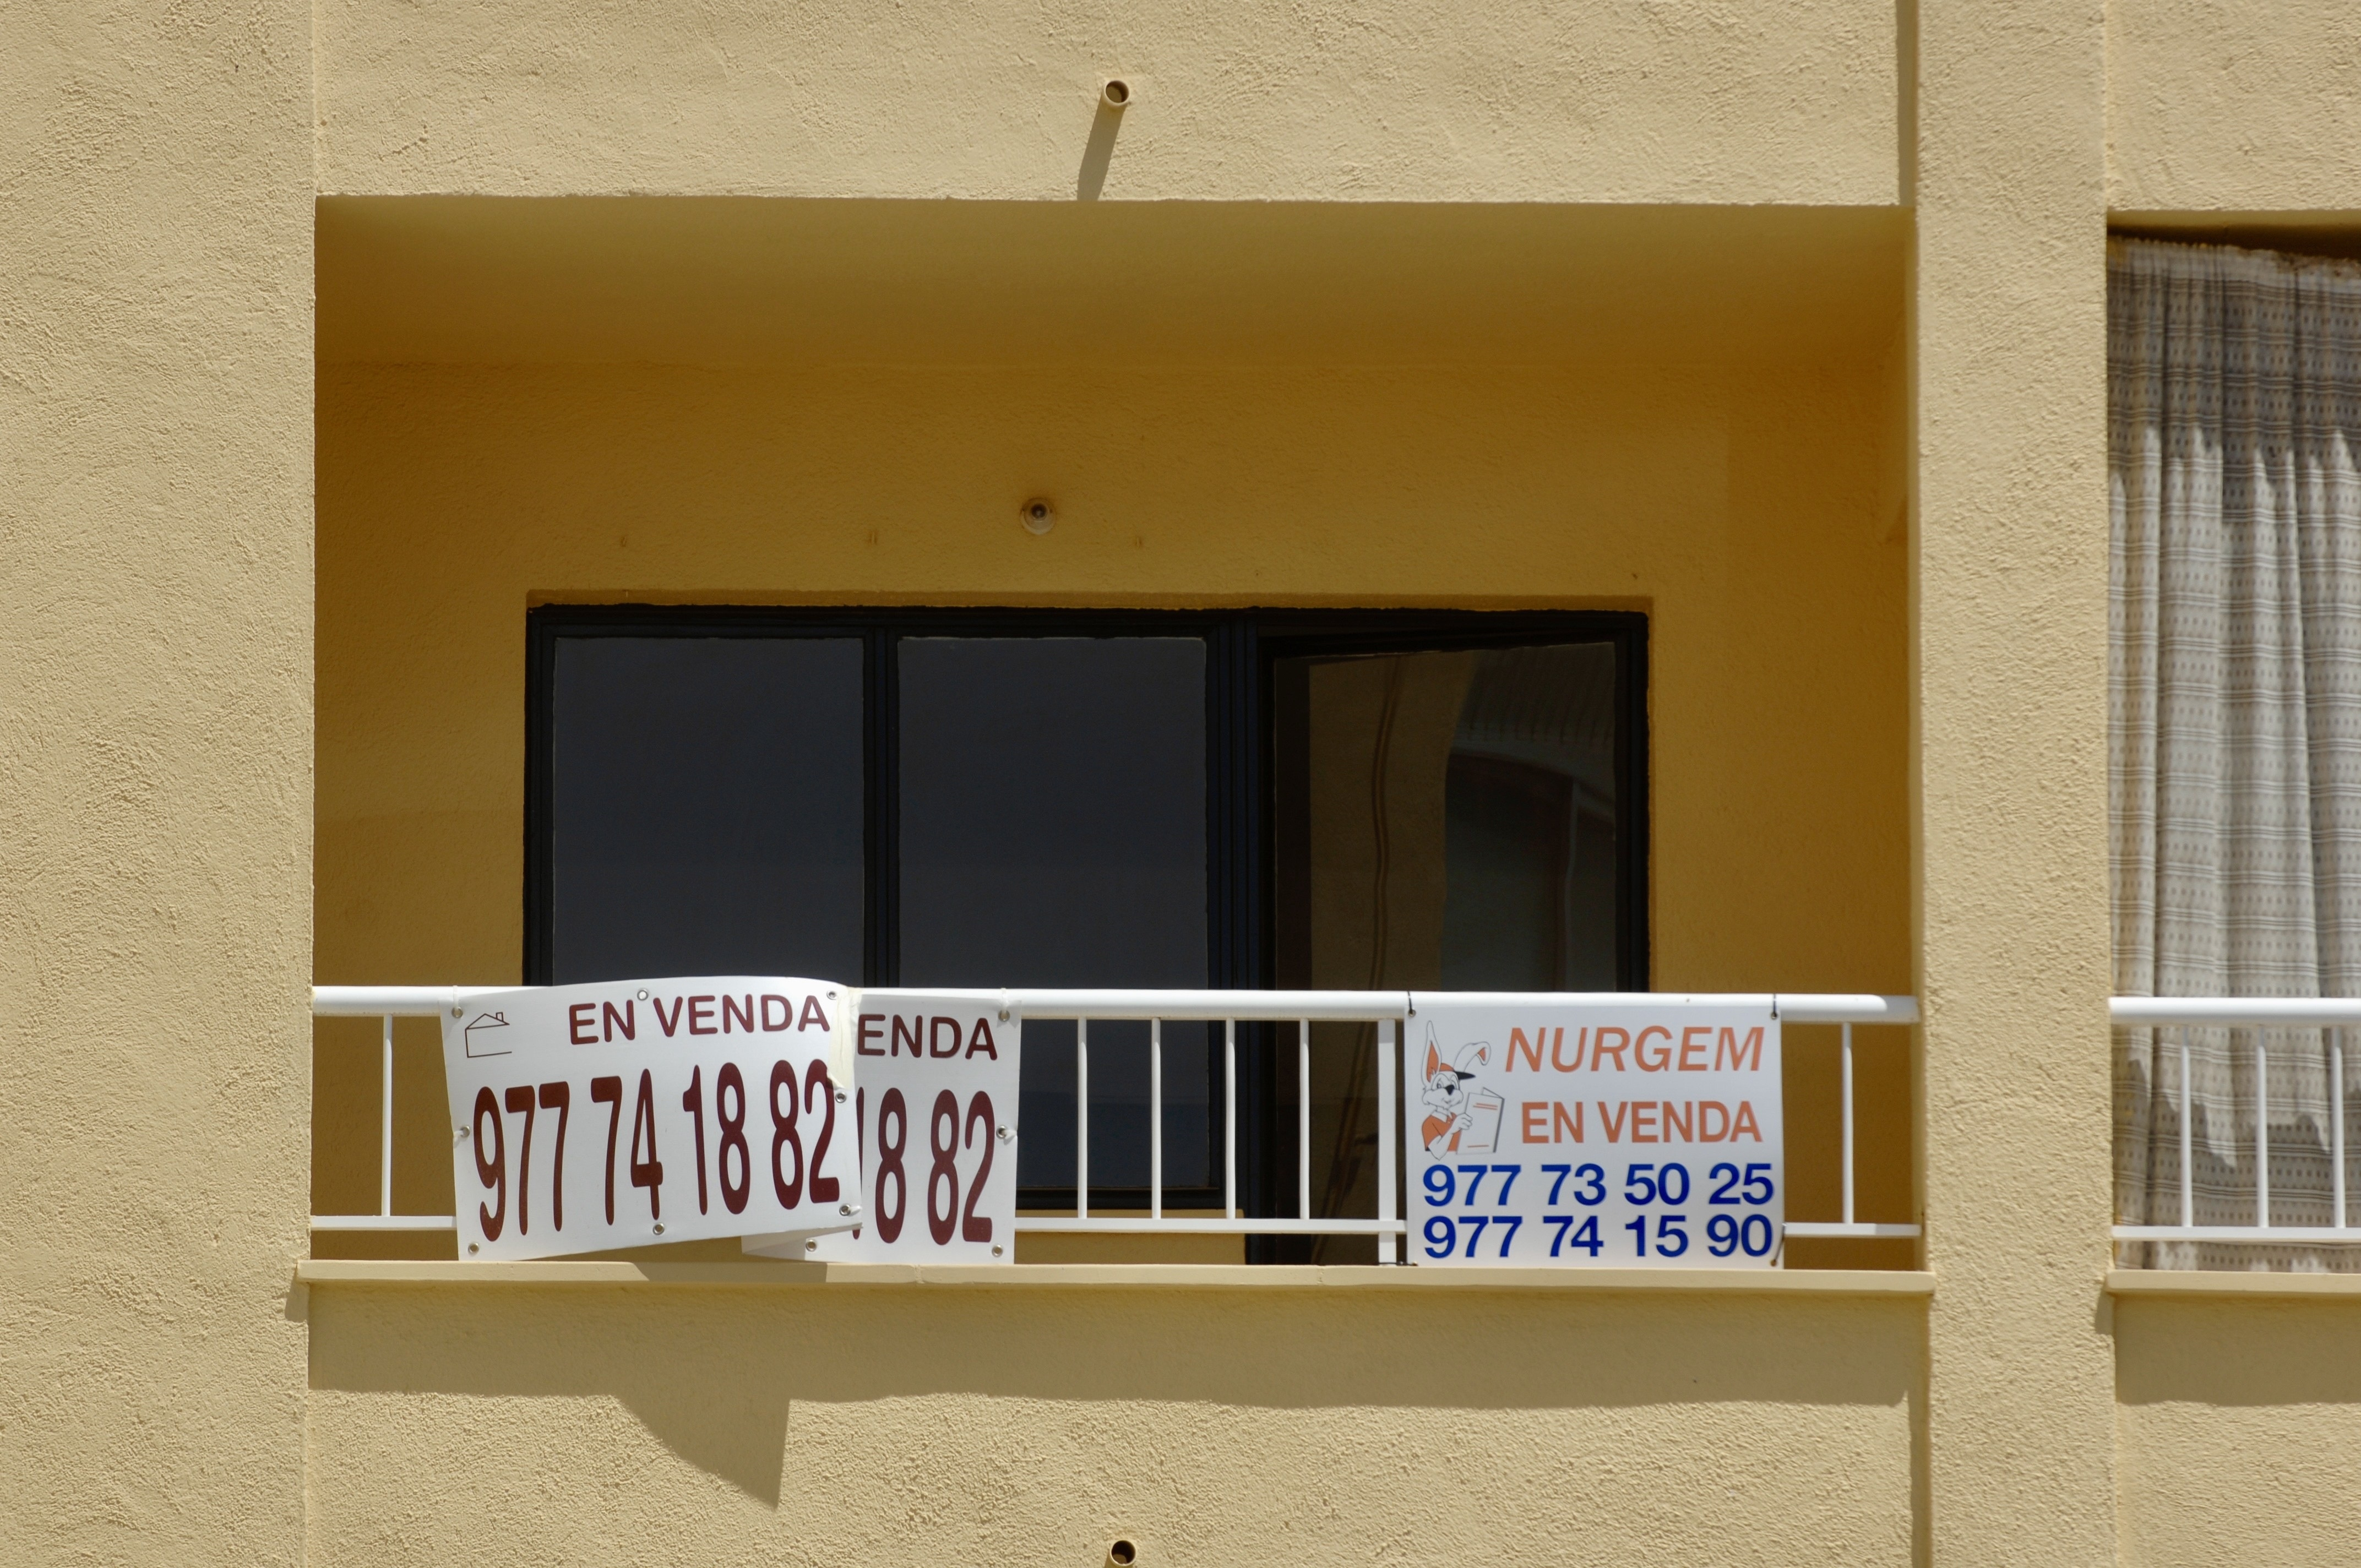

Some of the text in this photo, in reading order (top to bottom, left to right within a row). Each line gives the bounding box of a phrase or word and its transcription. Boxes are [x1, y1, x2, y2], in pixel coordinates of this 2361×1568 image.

[569, 994, 830, 1045] EN VENDA
[857, 1014, 998, 1061] ENDA
[1505, 1025, 1765, 1073] NURGEM
[1521, 1100, 1762, 1144] EN VENDA
[473, 1058, 840, 1242] 977 74 18 82
[927, 1089, 996, 1245] 82
[1422, 1162, 1775, 1207] 977 73 50 25
[1422, 1213, 1774, 1259] 977 74 15 90
